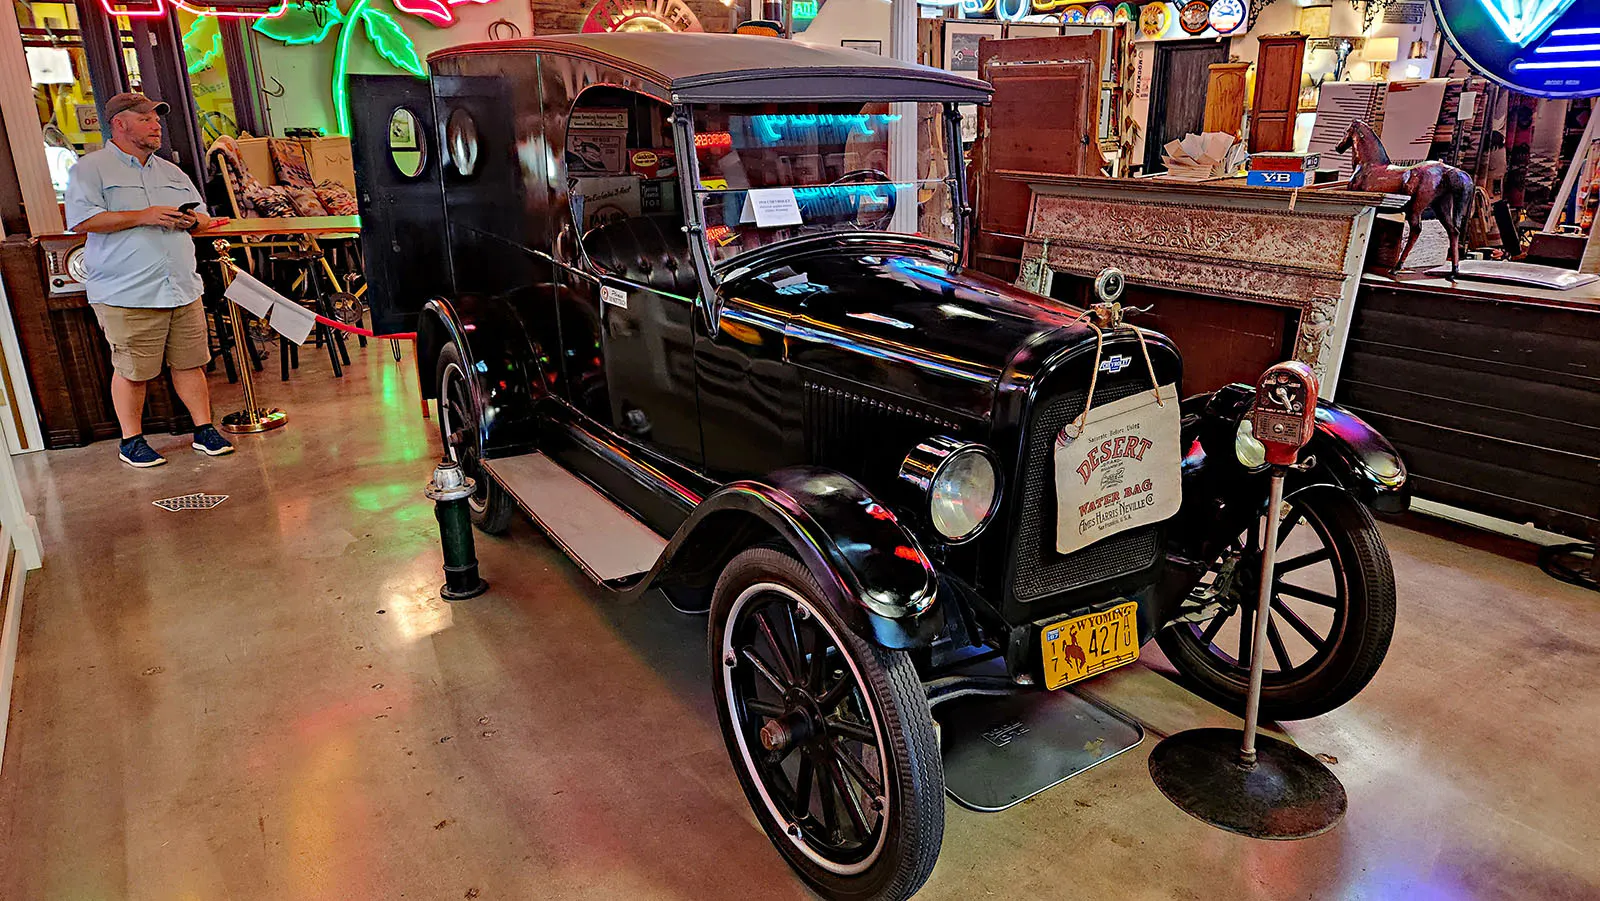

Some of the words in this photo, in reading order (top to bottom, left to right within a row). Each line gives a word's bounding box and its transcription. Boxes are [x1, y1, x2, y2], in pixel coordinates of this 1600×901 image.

[1076, 435, 1153, 485] DESERT
[1078, 491, 1120, 517] WATER
[1124, 479, 1153, 498] BAG
[1077, 605, 1133, 630] WYOMING
[1089, 621, 1120, 657] 427
